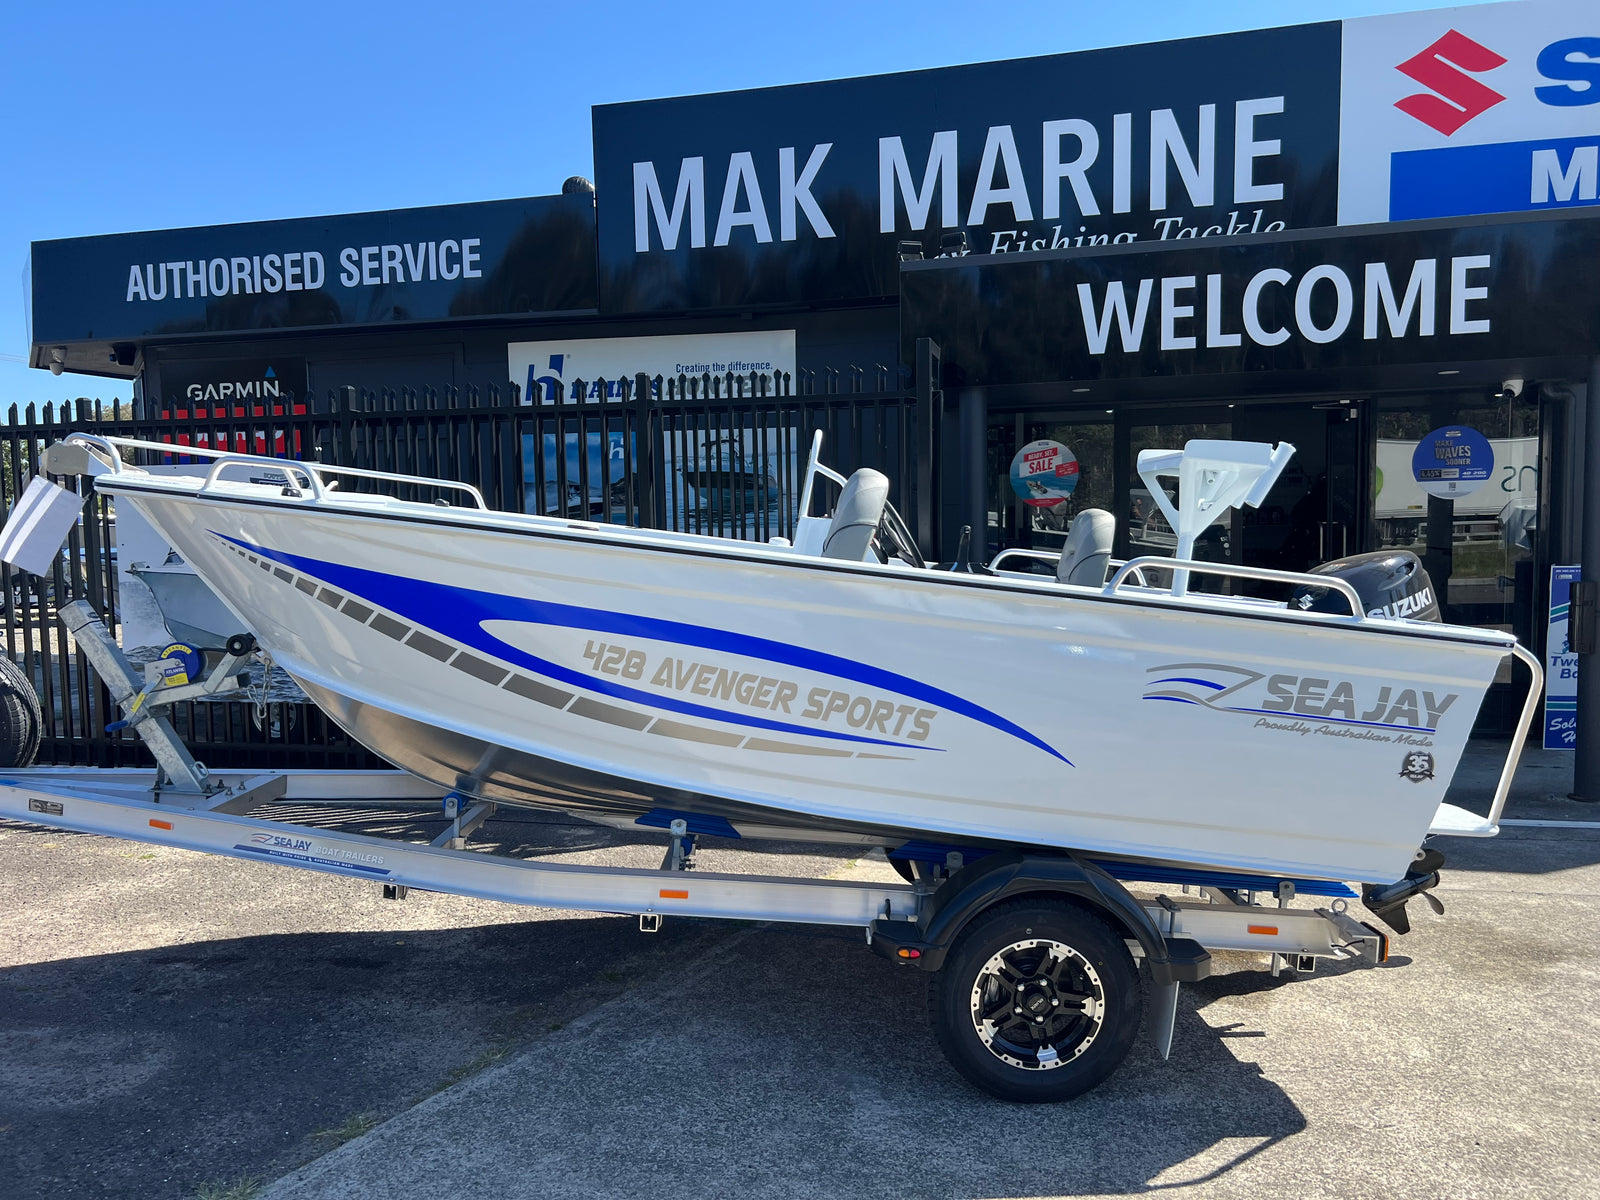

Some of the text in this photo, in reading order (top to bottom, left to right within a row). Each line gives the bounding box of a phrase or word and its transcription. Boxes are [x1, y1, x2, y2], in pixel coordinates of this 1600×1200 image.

[633, 97, 1286, 253] MAK MARINE
[1531, 146, 1600, 203] M
[126, 238, 482, 301] AUTHORISED SERVICE
[1076, 254, 1492, 355] WELCOME
[675, 360, 773, 373] Creating the difference.
[187, 380, 280, 401] GARMIN
[570, 379, 660, 399] HAINS
[1435, 445, 1471, 459] WAVES
[1029, 457, 1053, 474] SALE
[1367, 587, 1432, 620] SUZUKI
[583, 640, 938, 742] 428 AVENGER SPORTS
[1254, 718, 1434, 747] Proudly Australian Made
[1408, 755, 1429, 772] 35
[315, 847, 384, 864] BOAT TRAILERS
